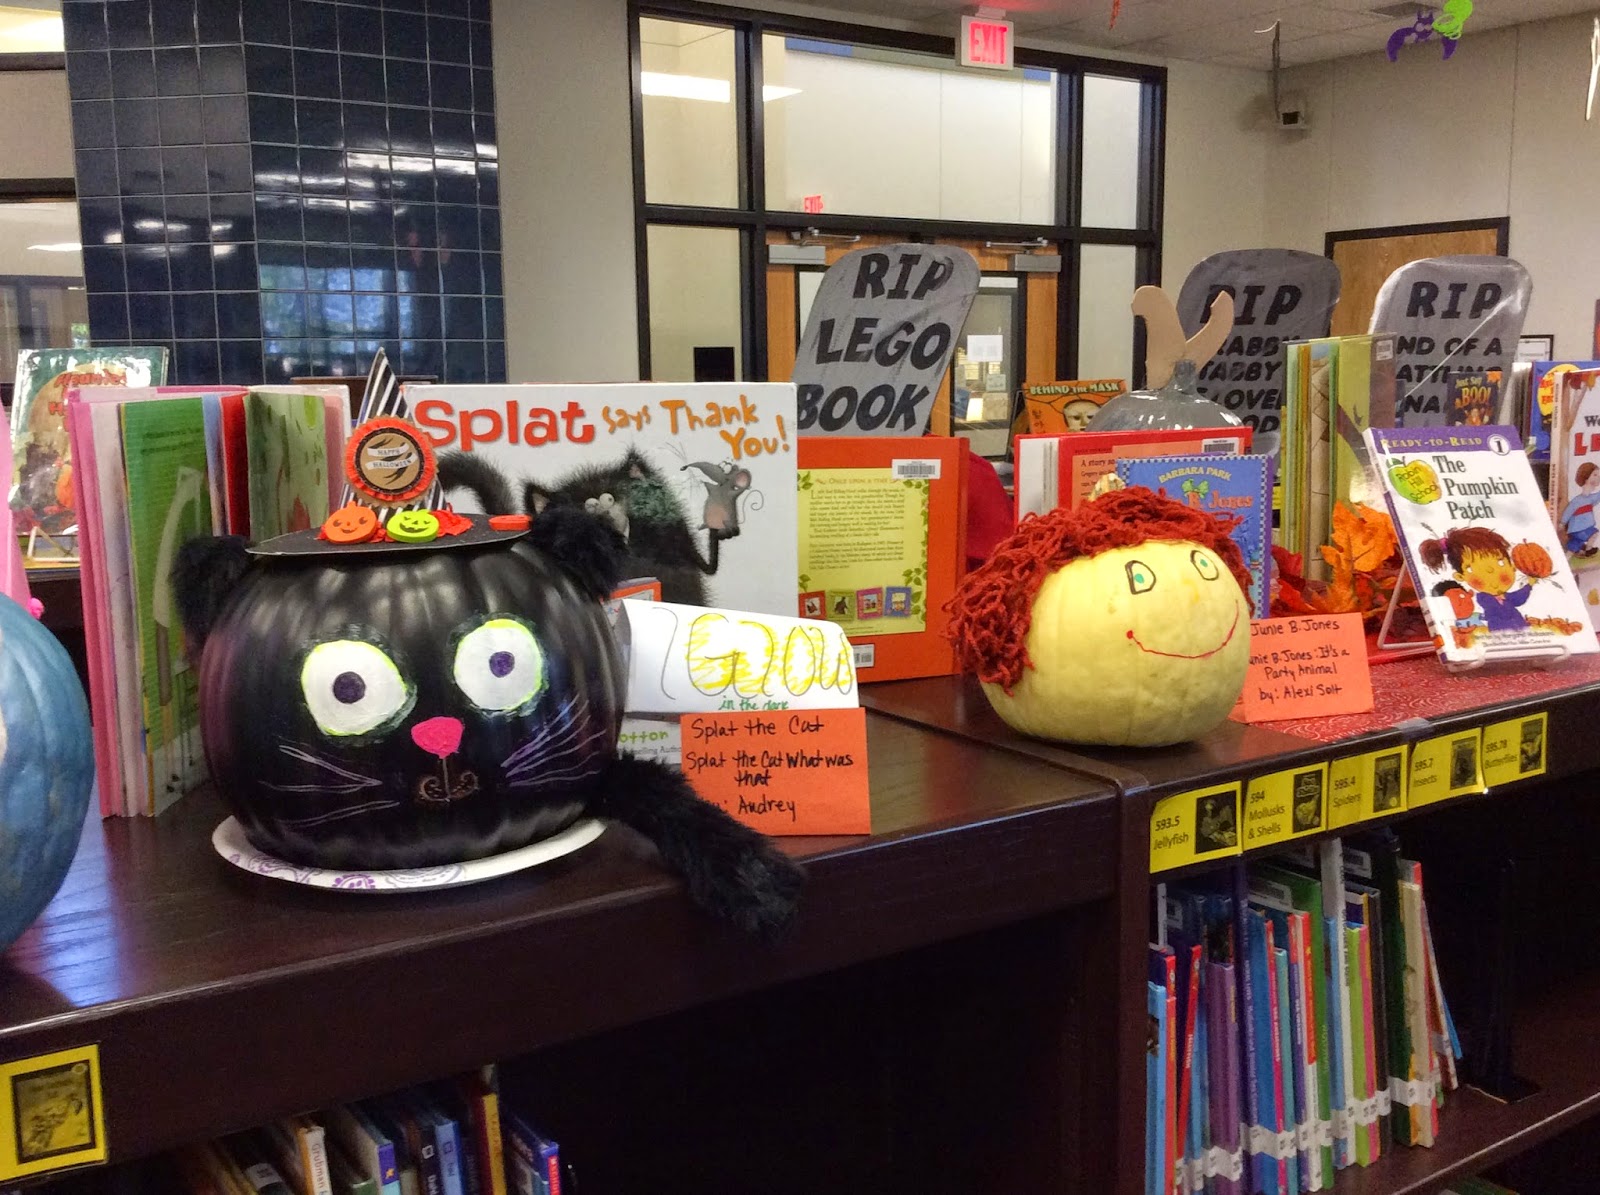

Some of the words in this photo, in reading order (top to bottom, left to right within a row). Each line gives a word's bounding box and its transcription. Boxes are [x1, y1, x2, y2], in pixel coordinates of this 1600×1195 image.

[970, 22, 1007, 64] EXIT
[853, 253, 954, 300] RIP
[1406, 281, 1502, 319] RIP
[816, 317, 951, 371] LEGO
[1444, 337, 1480, 356] OF
[1484, 337, 1503, 356] A
[1029, 385, 1070, 395] BEHIND
[1072, 385, 1088, 393] THE
[1089, 382, 1119, 393] MASK
[1461, 386, 1492, 408] BOO!
[797, 383, 930, 432] BOOK
[414, 399, 595, 452] Splat
[659, 394, 759, 434] Thank
[719, 415, 790, 460] You!
[377, 448, 400, 456] HAPPY
[1494, 440, 1505, 454] 1
[373, 459, 412, 468] HALLOWEEN
[1432, 455, 1467, 474] The
[1159, 466, 1204, 484] BARBARA
[1206, 467, 1232, 481] PARK
[1396, 465, 1425, 483] Robin
[1408, 476, 1425, 489] Hill
[1410, 483, 1440, 503] School
[1442, 477, 1520, 500] Pumpkin
[1208, 490, 1253, 509] Jones
[1446, 500, 1497, 521] Patch
[1250, 622, 1283, 636] Junie
[1288, 620, 1301, 633] B.
[1301, 619, 1340, 631] Jones
[1271, 652, 1282, 664] B.
[1264, 666, 1296, 681] Party
[1298, 662, 1337, 676] Animal
[718, 695, 735, 711] in
[739, 697, 759, 711] the
[763, 699, 788, 711] dark
[1258, 687, 1279, 704] by:
[1283, 684, 1313, 699] Alexi
[691, 718, 739, 744] Splat
[744, 717, 776, 736] the
[788, 714, 825, 735] Cat
[686, 751, 727, 774] Splat
[732, 750, 758, 768] the
[761, 750, 783, 768] Cat
[786, 748, 823, 769] What
[824, 754, 854, 768] was
[734, 769, 772, 787] that
[1333, 776, 1356, 791] 595.4
[1413, 774, 1438, 787] Insects
[1250, 790, 1266, 804] 594
[1333, 793, 1362, 808] Spiders
[738, 794, 797, 822] Audrey
[1249, 804, 1286, 821] Mollusks
[1155, 815, 1181, 832] 593.5
[1247, 828, 1255, 840] &
[1257, 822, 1281, 837] Shells
[1154, 832, 1189, 850] Jellyfish
